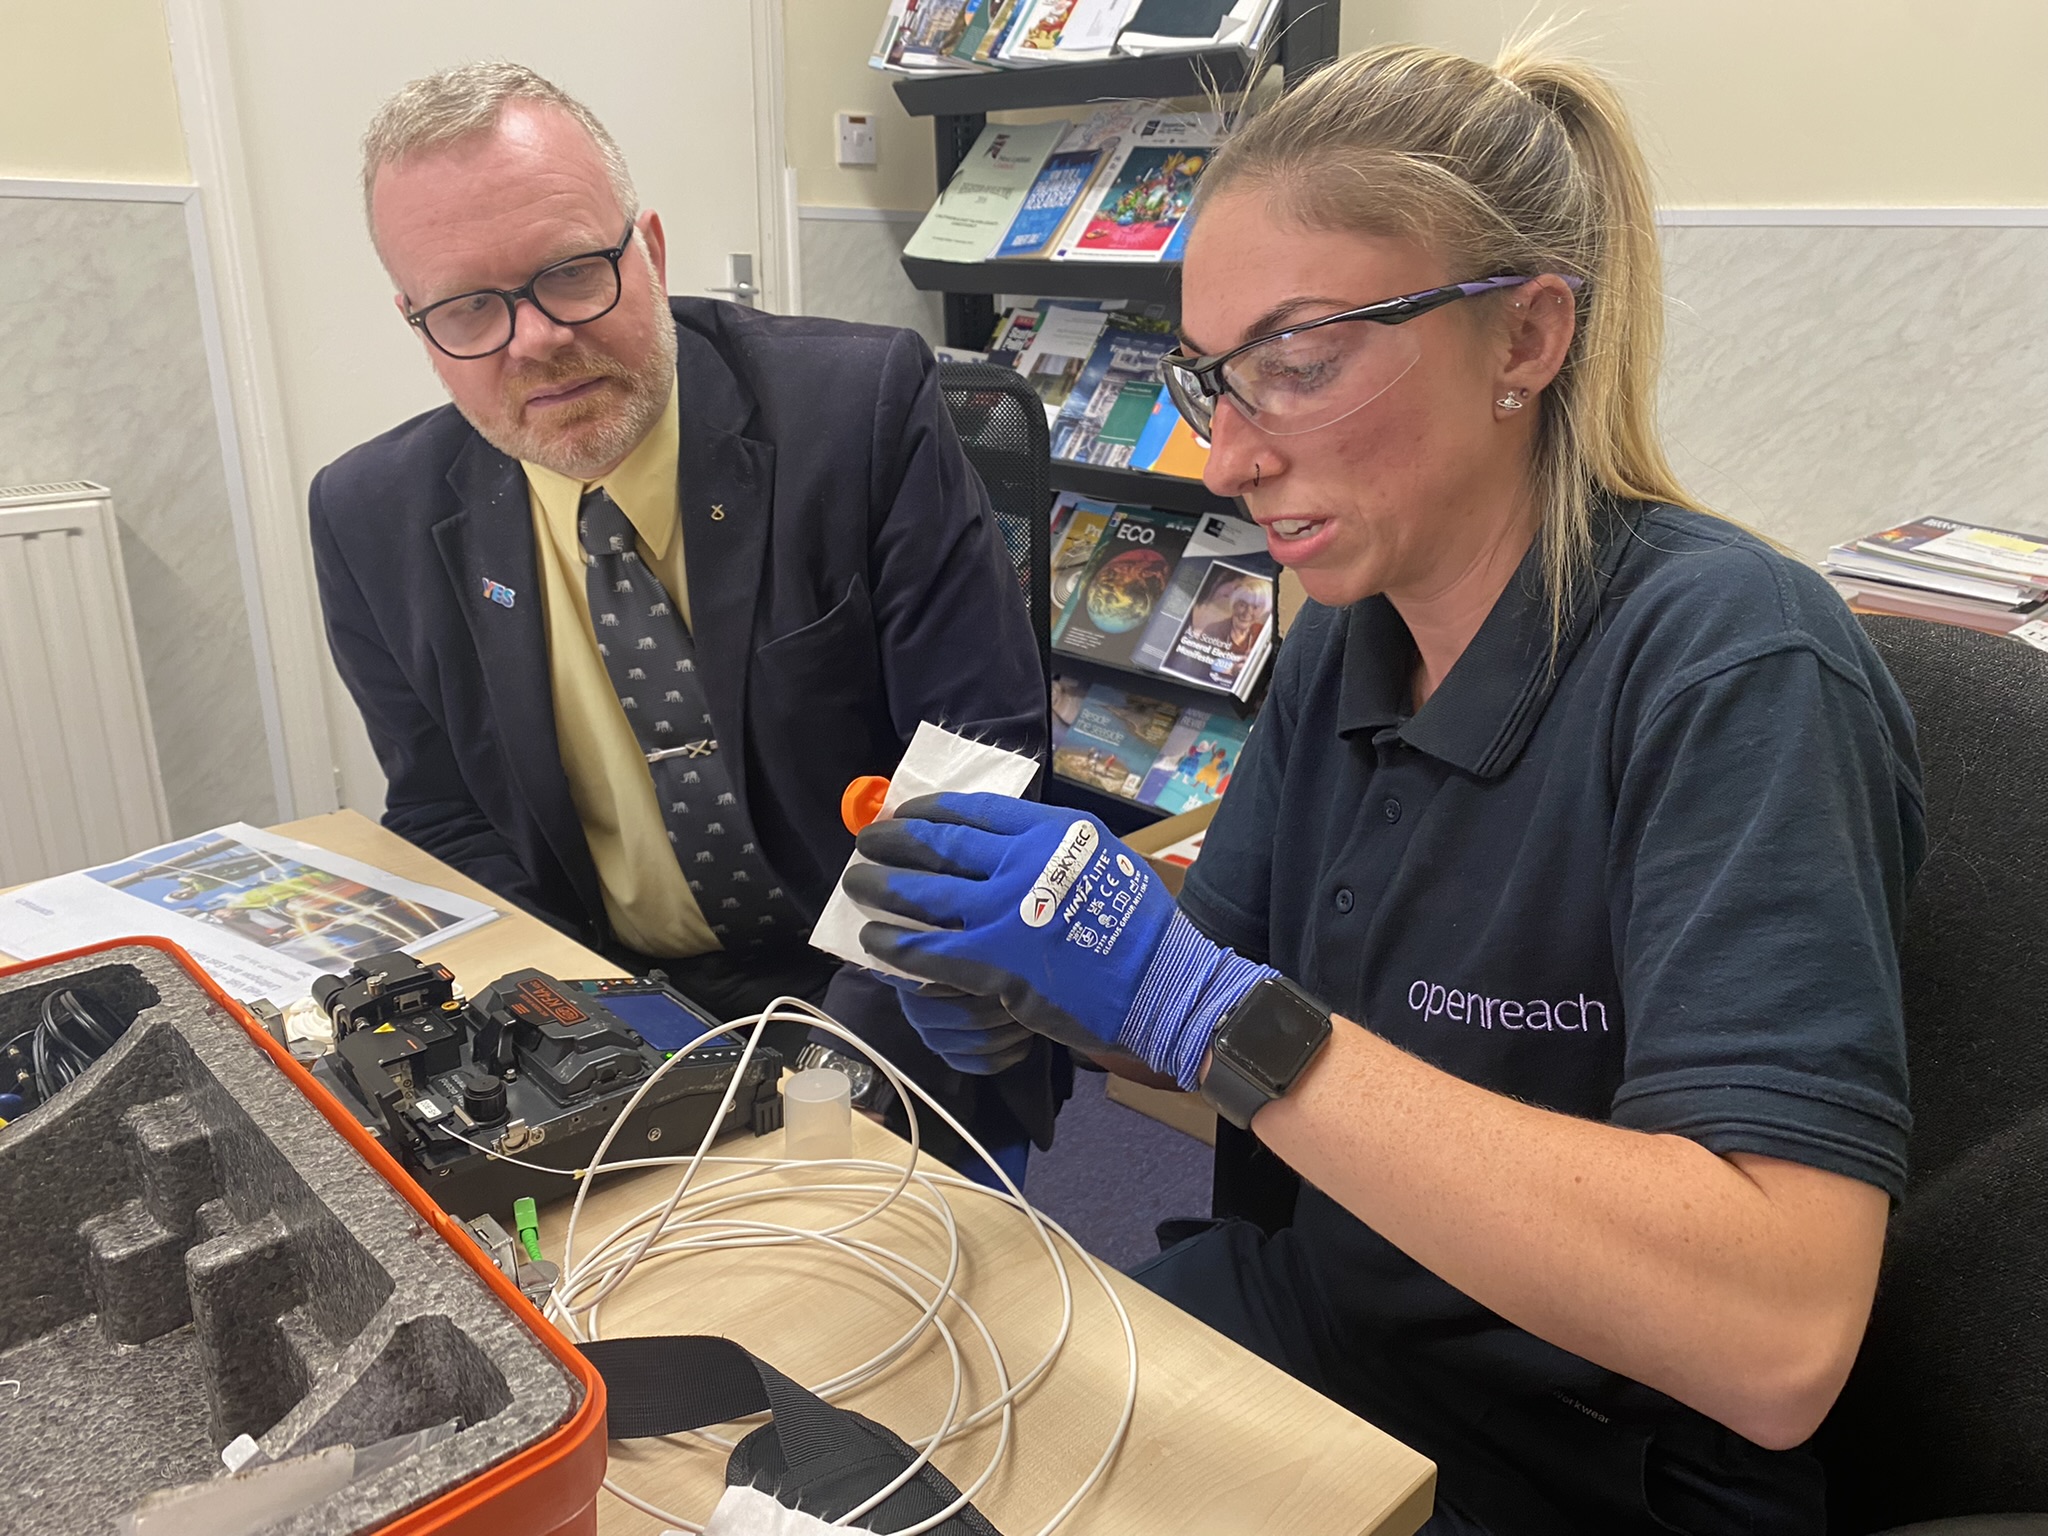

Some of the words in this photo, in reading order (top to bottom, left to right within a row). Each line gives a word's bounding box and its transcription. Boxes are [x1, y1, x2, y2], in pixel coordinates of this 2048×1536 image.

[1116, 523, 1156, 545] ECO
[482, 577, 516, 608] YES
[1176, 645, 1214, 665] Manifesto
[1180, 636, 1212, 654] General
[1211, 647, 1242, 663] Election
[1200, 633, 1232, 650] Scotland
[1050, 828, 1091, 886] SKYTEC
[1063, 874, 1093, 924] NINJA
[1102, 926, 1123, 955] GLOBUS
[1408, 980, 1608, 1032] openreach
